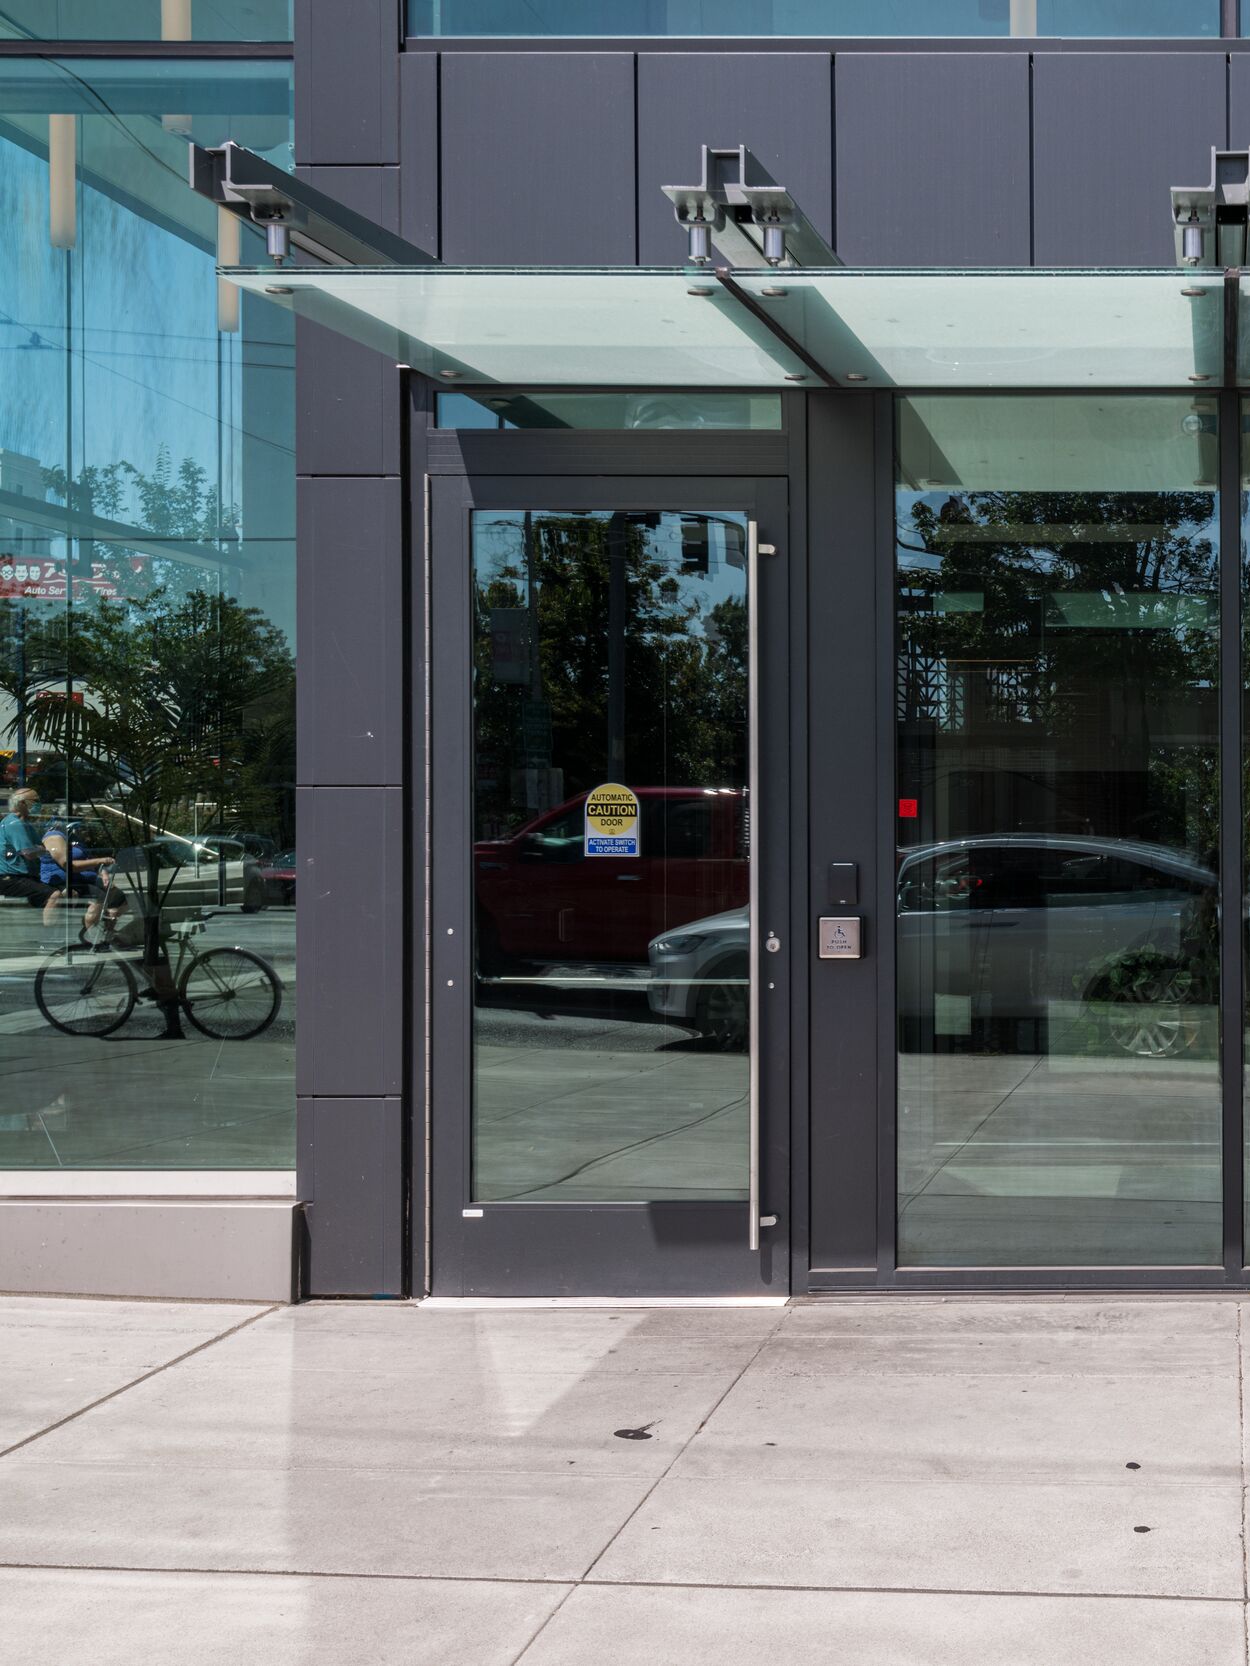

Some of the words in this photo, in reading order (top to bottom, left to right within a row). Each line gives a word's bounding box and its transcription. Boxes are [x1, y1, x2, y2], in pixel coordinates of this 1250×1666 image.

[24, 586, 47, 595] Auto
[591, 793, 633, 801] AUTOMATIC
[588, 805, 636, 815] CAUTION
[601, 818, 623, 826] DOOR
